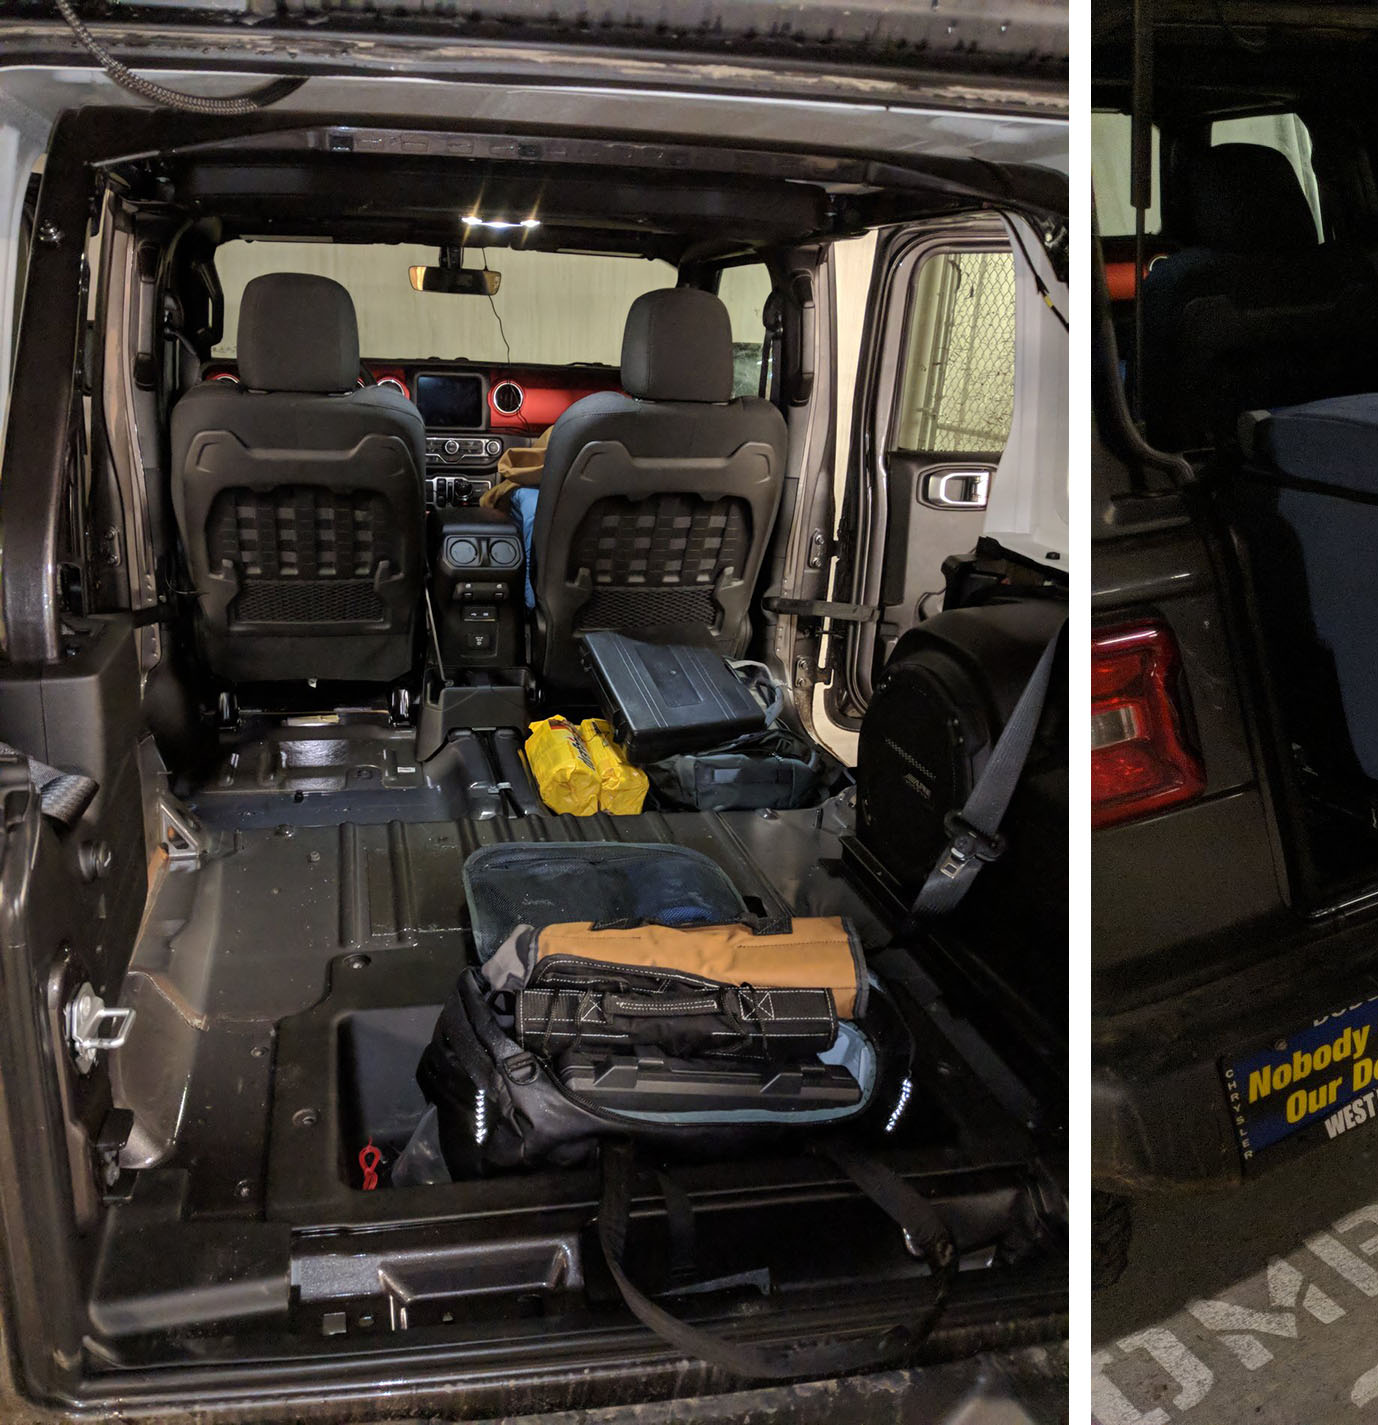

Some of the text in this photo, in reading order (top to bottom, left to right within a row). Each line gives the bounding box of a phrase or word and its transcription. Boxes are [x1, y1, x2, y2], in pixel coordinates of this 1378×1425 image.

[1248, 1024, 1371, 1104] Nobody
[1224, 1069, 1254, 1161] CHRYSLER
[1286, 1076, 1343, 1124] Our
[1323, 1092, 1376, 1139] WEST
